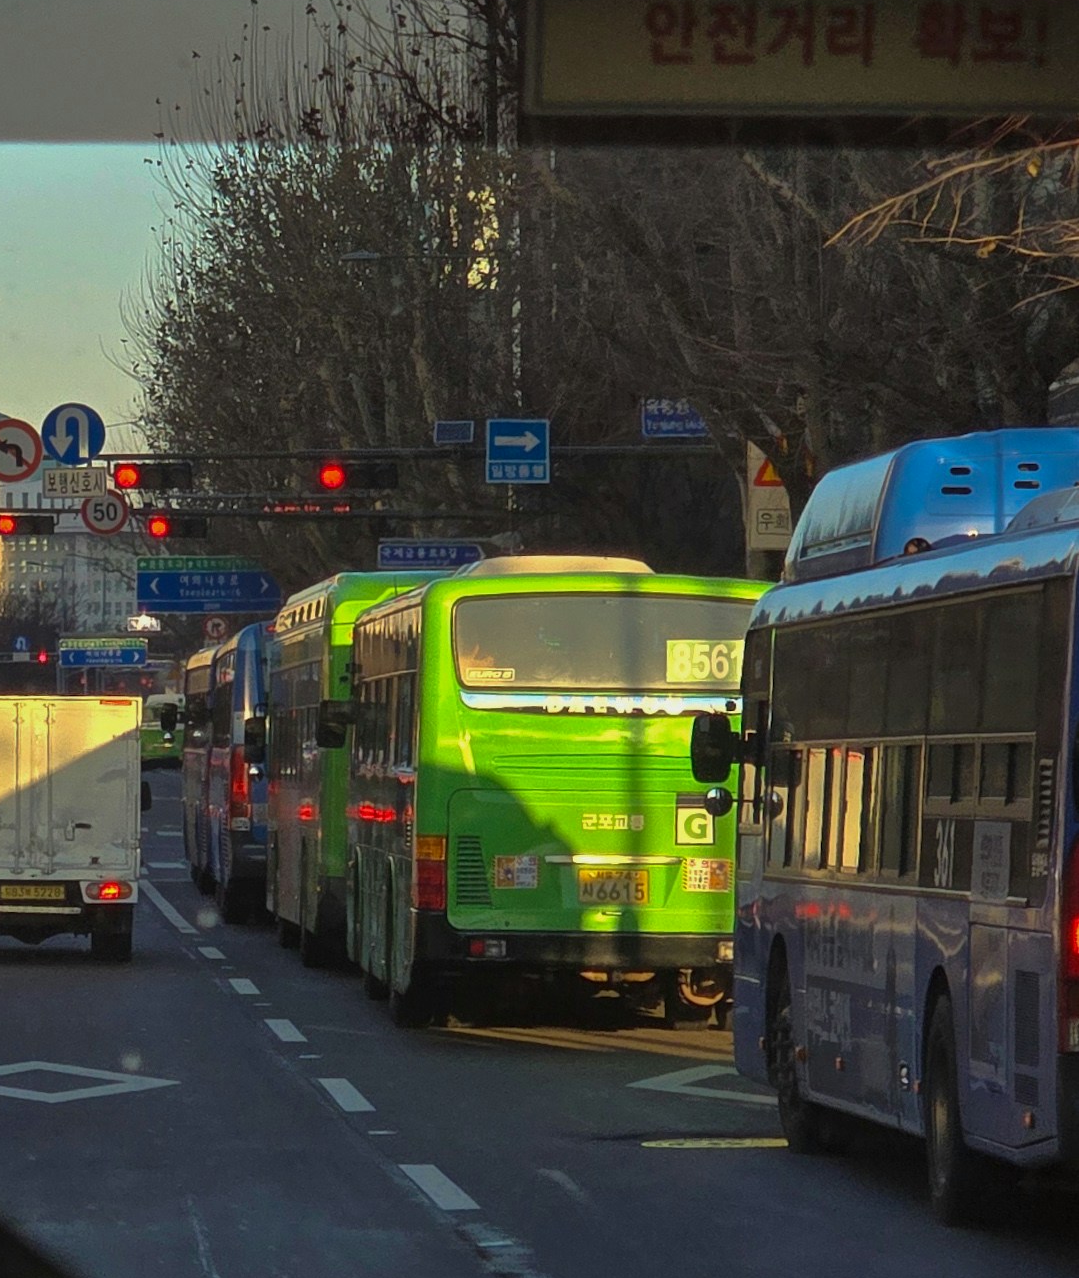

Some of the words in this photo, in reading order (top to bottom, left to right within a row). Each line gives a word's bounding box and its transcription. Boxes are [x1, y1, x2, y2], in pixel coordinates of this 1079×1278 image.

[491, 463, 545, 479] 일방통행
[47, 471, 103, 494] 보행신호시
[93, 502, 118, 522] 50
[672, 643, 742, 680] 8561
[469, 670, 503, 679] EURO
[683, 812, 708, 839] G
